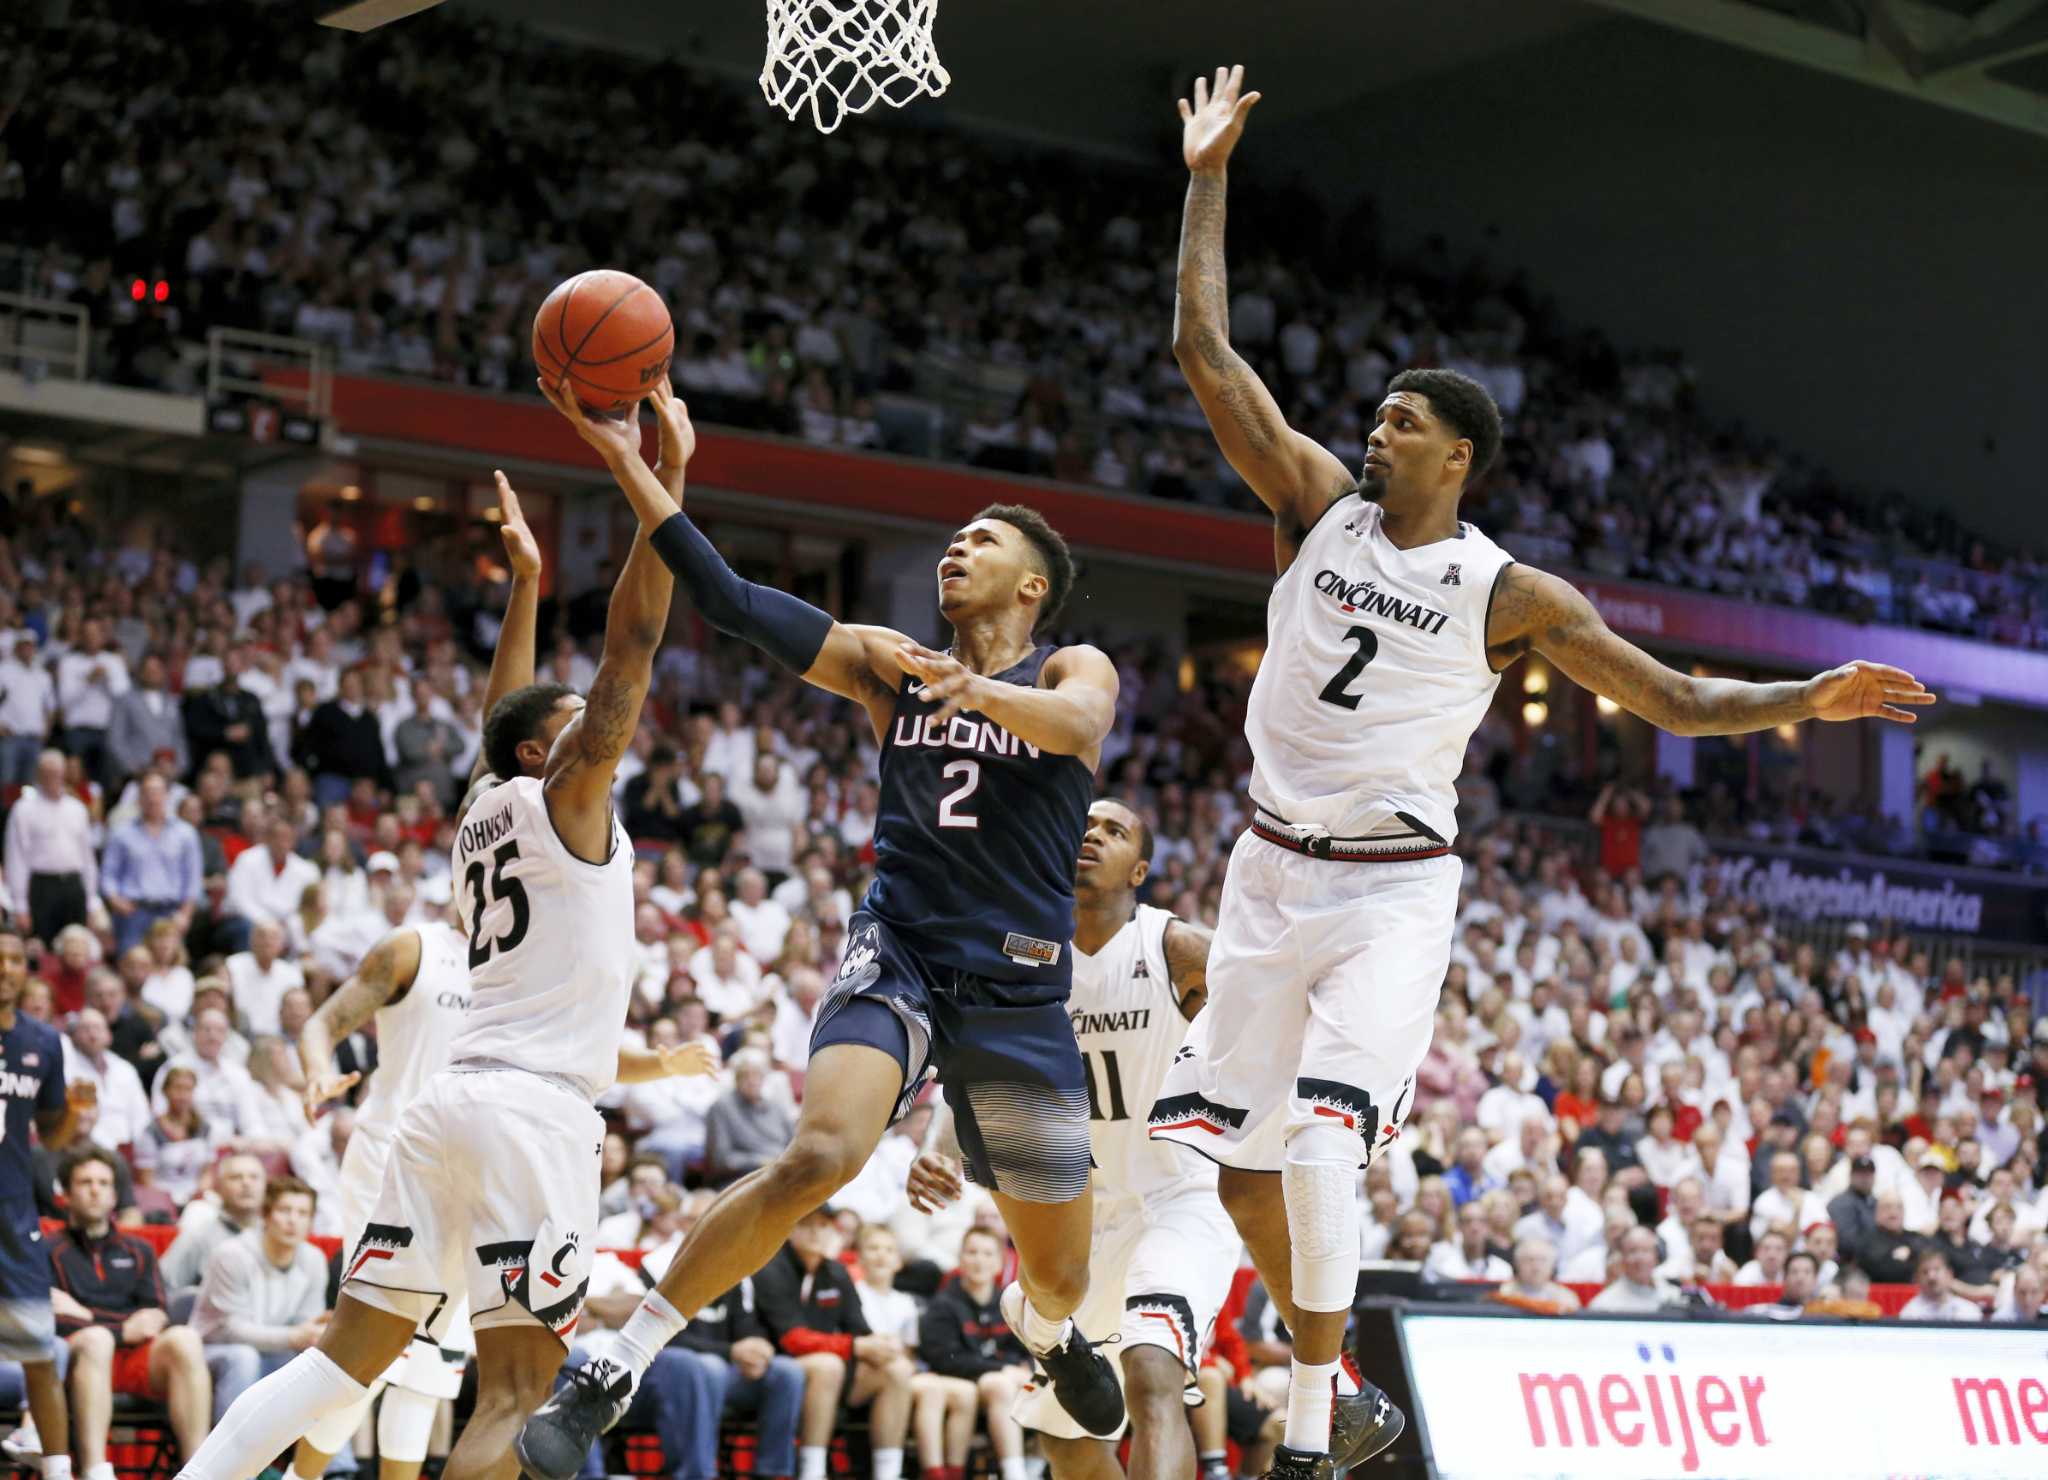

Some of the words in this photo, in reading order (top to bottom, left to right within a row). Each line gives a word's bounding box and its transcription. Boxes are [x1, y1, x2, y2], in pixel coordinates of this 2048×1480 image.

[1314, 569, 1449, 635] CINCINNATI
[1318, 625, 1378, 710] 2
[938, 760, 980, 828] 2
[465, 839, 530, 971] 25
[1081, 1050, 1131, 1121] 11
[1518, 1341, 1771, 1472] meijer
